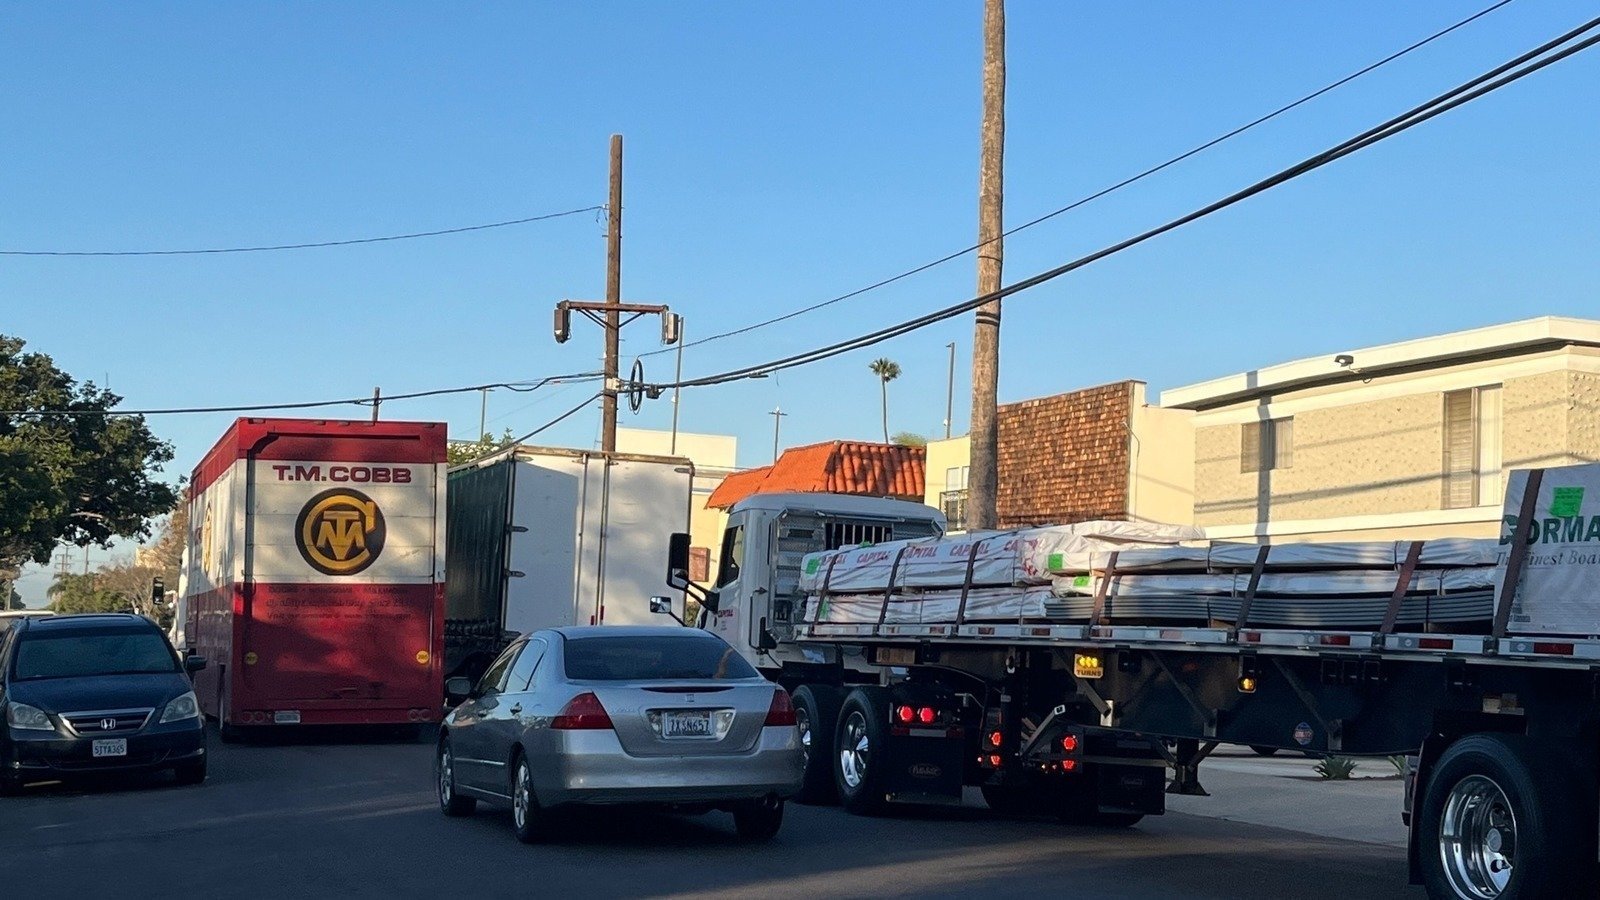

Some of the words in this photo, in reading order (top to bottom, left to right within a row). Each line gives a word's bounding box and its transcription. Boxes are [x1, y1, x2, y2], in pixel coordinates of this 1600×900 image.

[950, 543, 990, 556] CAPAL
[1566, 550, 1600, 565] Boa
[1076, 669, 1102, 677] TURNS
